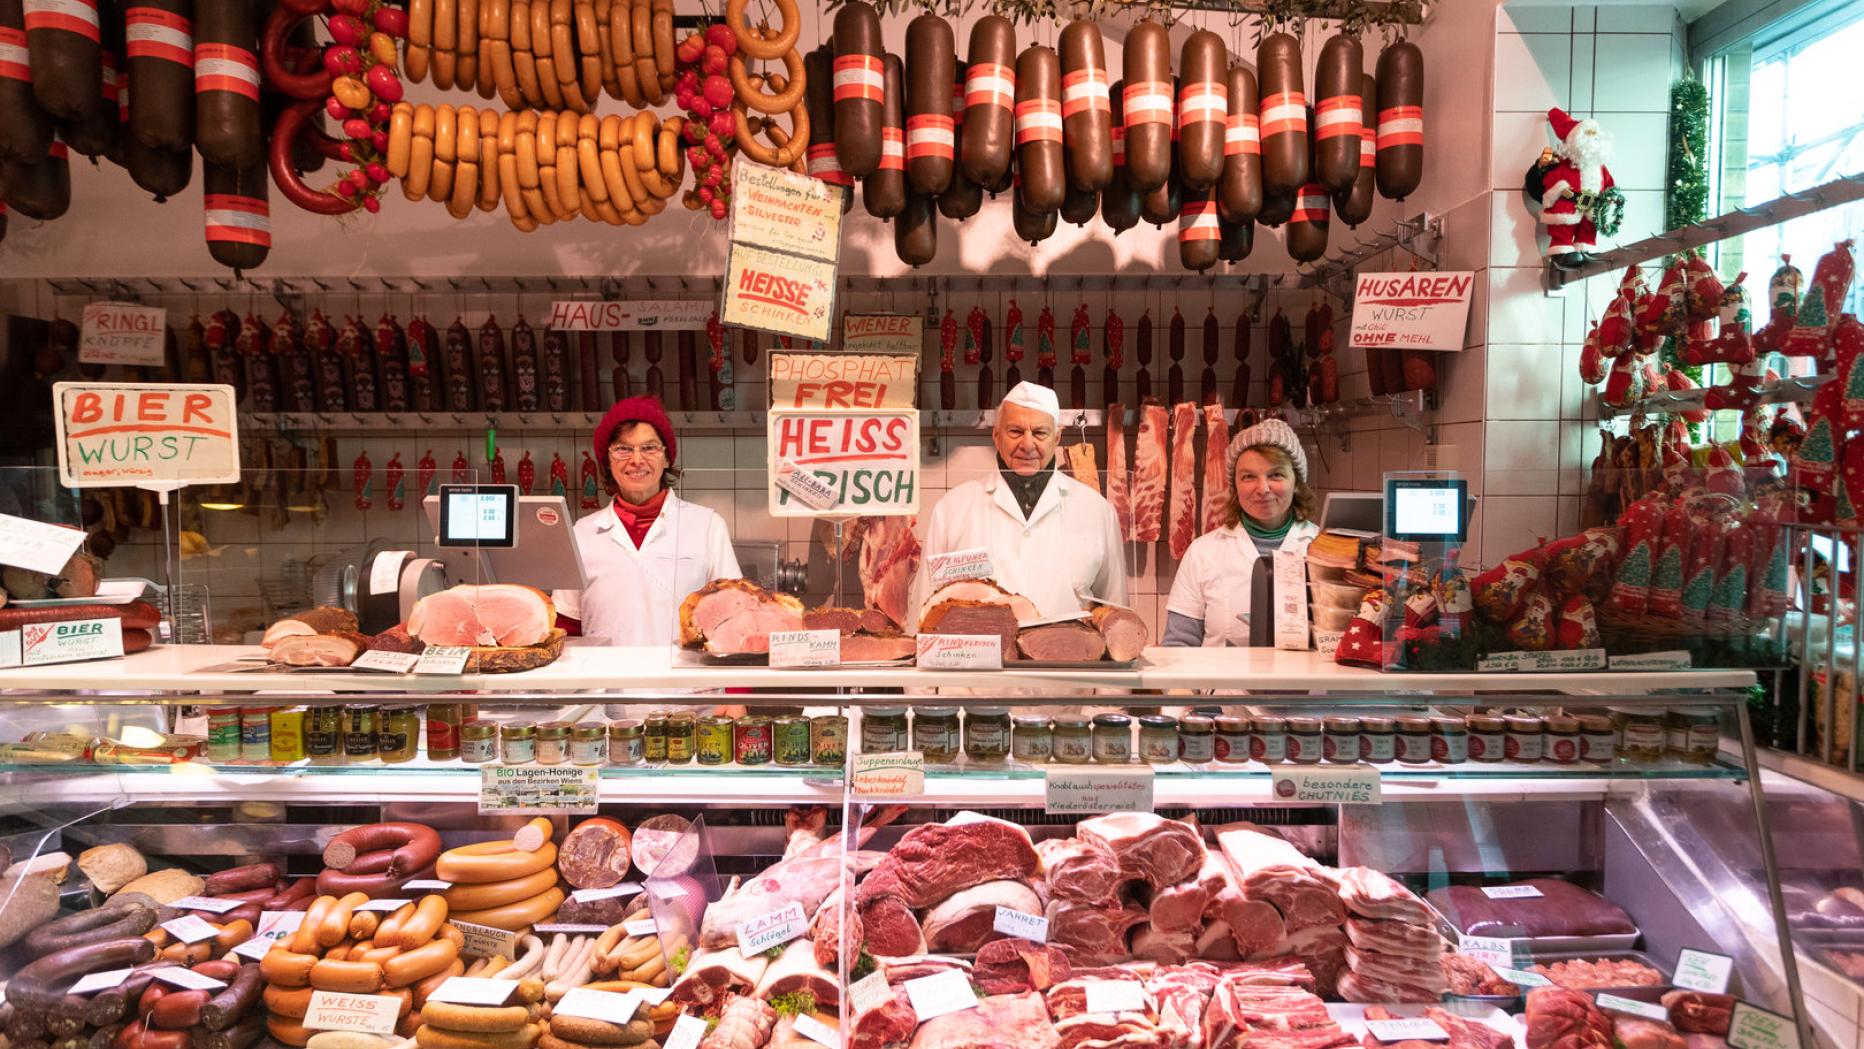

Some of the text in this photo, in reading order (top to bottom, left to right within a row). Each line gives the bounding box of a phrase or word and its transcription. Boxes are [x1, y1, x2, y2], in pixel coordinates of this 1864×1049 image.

[739, 167, 801, 198] Bestellungen
[748, 189, 823, 217] WEIHNACHTEN
[747, 205, 801, 228] SILVESTER
[739, 268, 813, 307] HEISSE
[1358, 275, 1472, 297] HUSAREN
[96, 313, 163, 332] RINGL
[551, 302, 705, 329] HAUS- SALAMI
[739, 302, 813, 325] SCHINKEN
[1372, 307, 1433, 321] WURST
[847, 318, 911, 332] WIENER
[1353, 333, 1433, 344] OHNE MEHL
[774, 358, 914, 381] PHOSPHAT
[794, 380, 887, 409] FREI
[71, 392, 214, 424] BIER
[779, 417, 907, 457] HEISS
[78, 436, 208, 465] WURST
[57, 623, 104, 636] BIER
[425, 646, 468, 656] BEIN
[809, 641, 837, 649] KAMM
[496, 767, 583, 779] BIO Lagen-Honige
[1302, 777, 1373, 790] besondere
[745, 907, 797, 934] LAMM
[1462, 939, 1505, 950] KALBS
[321, 996, 379, 1010] WEISS
